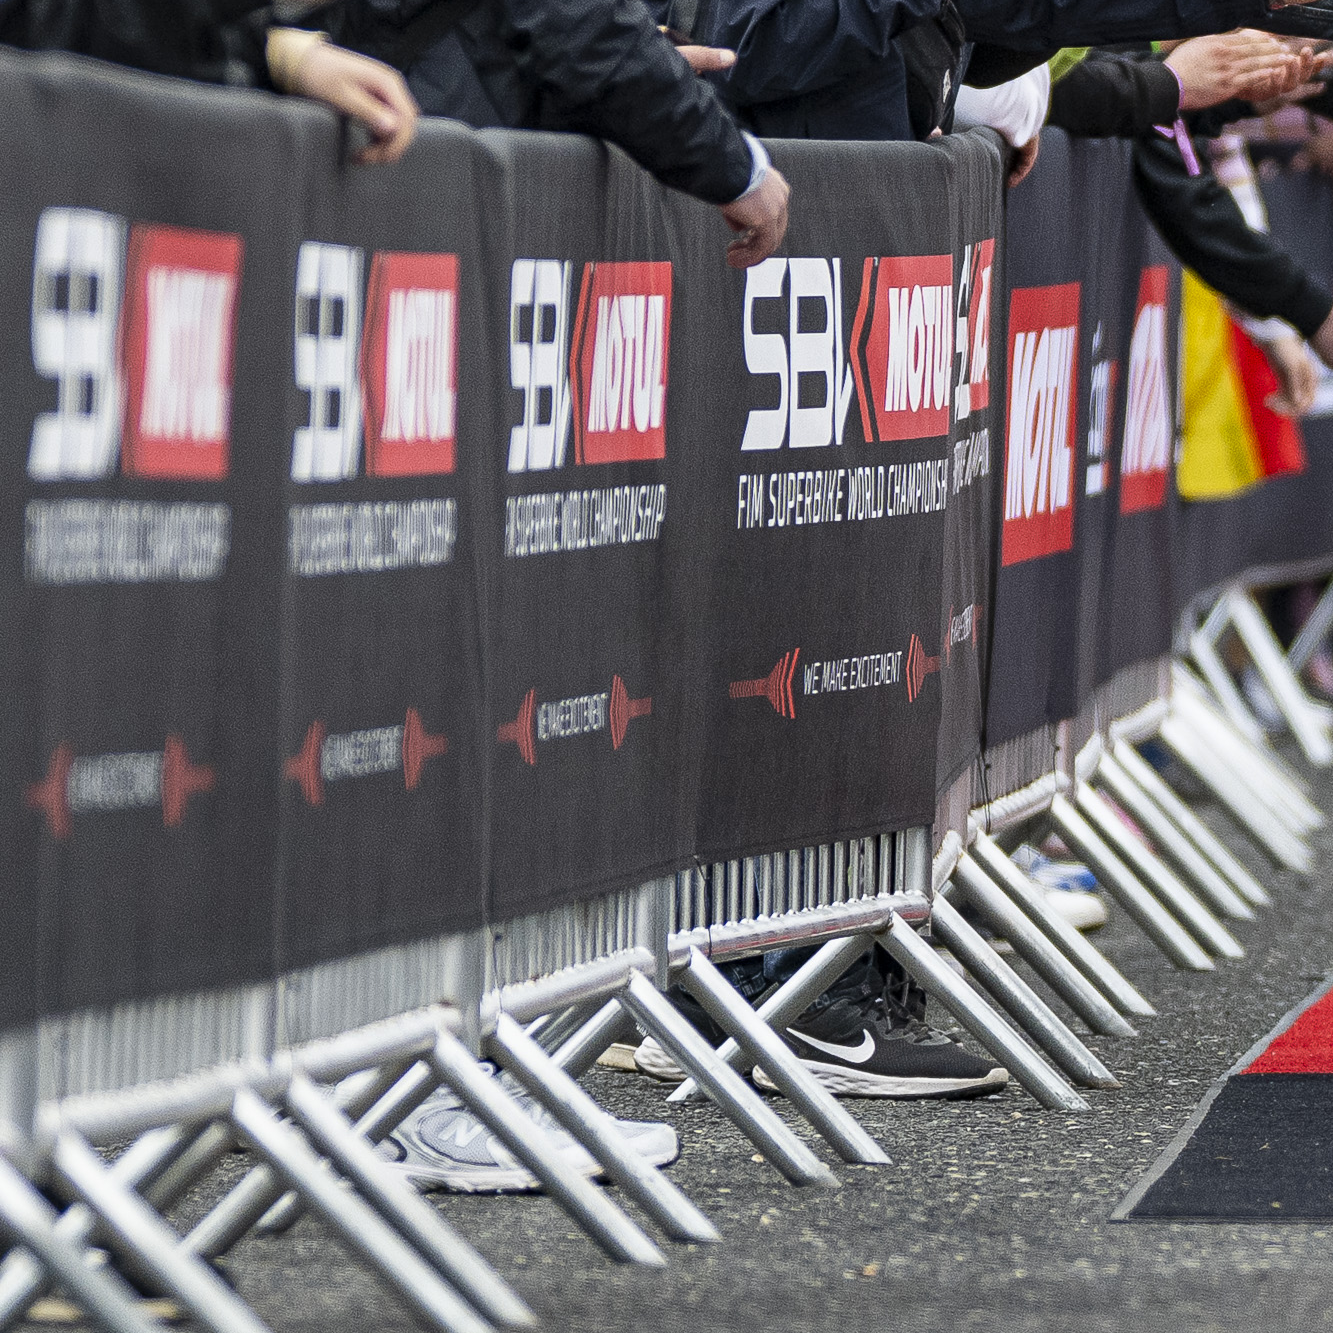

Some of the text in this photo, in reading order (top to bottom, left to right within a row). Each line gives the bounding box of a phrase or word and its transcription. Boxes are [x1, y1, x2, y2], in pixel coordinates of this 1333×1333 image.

[587, 294, 665, 433] MOTUL
[741, 257, 853, 451] SBK
[737, 458, 948, 530] FIM SUPERBIKE WORLD CHAMPIONSH
[804, 651, 903, 696] WE MAKE EXCITEMENT
